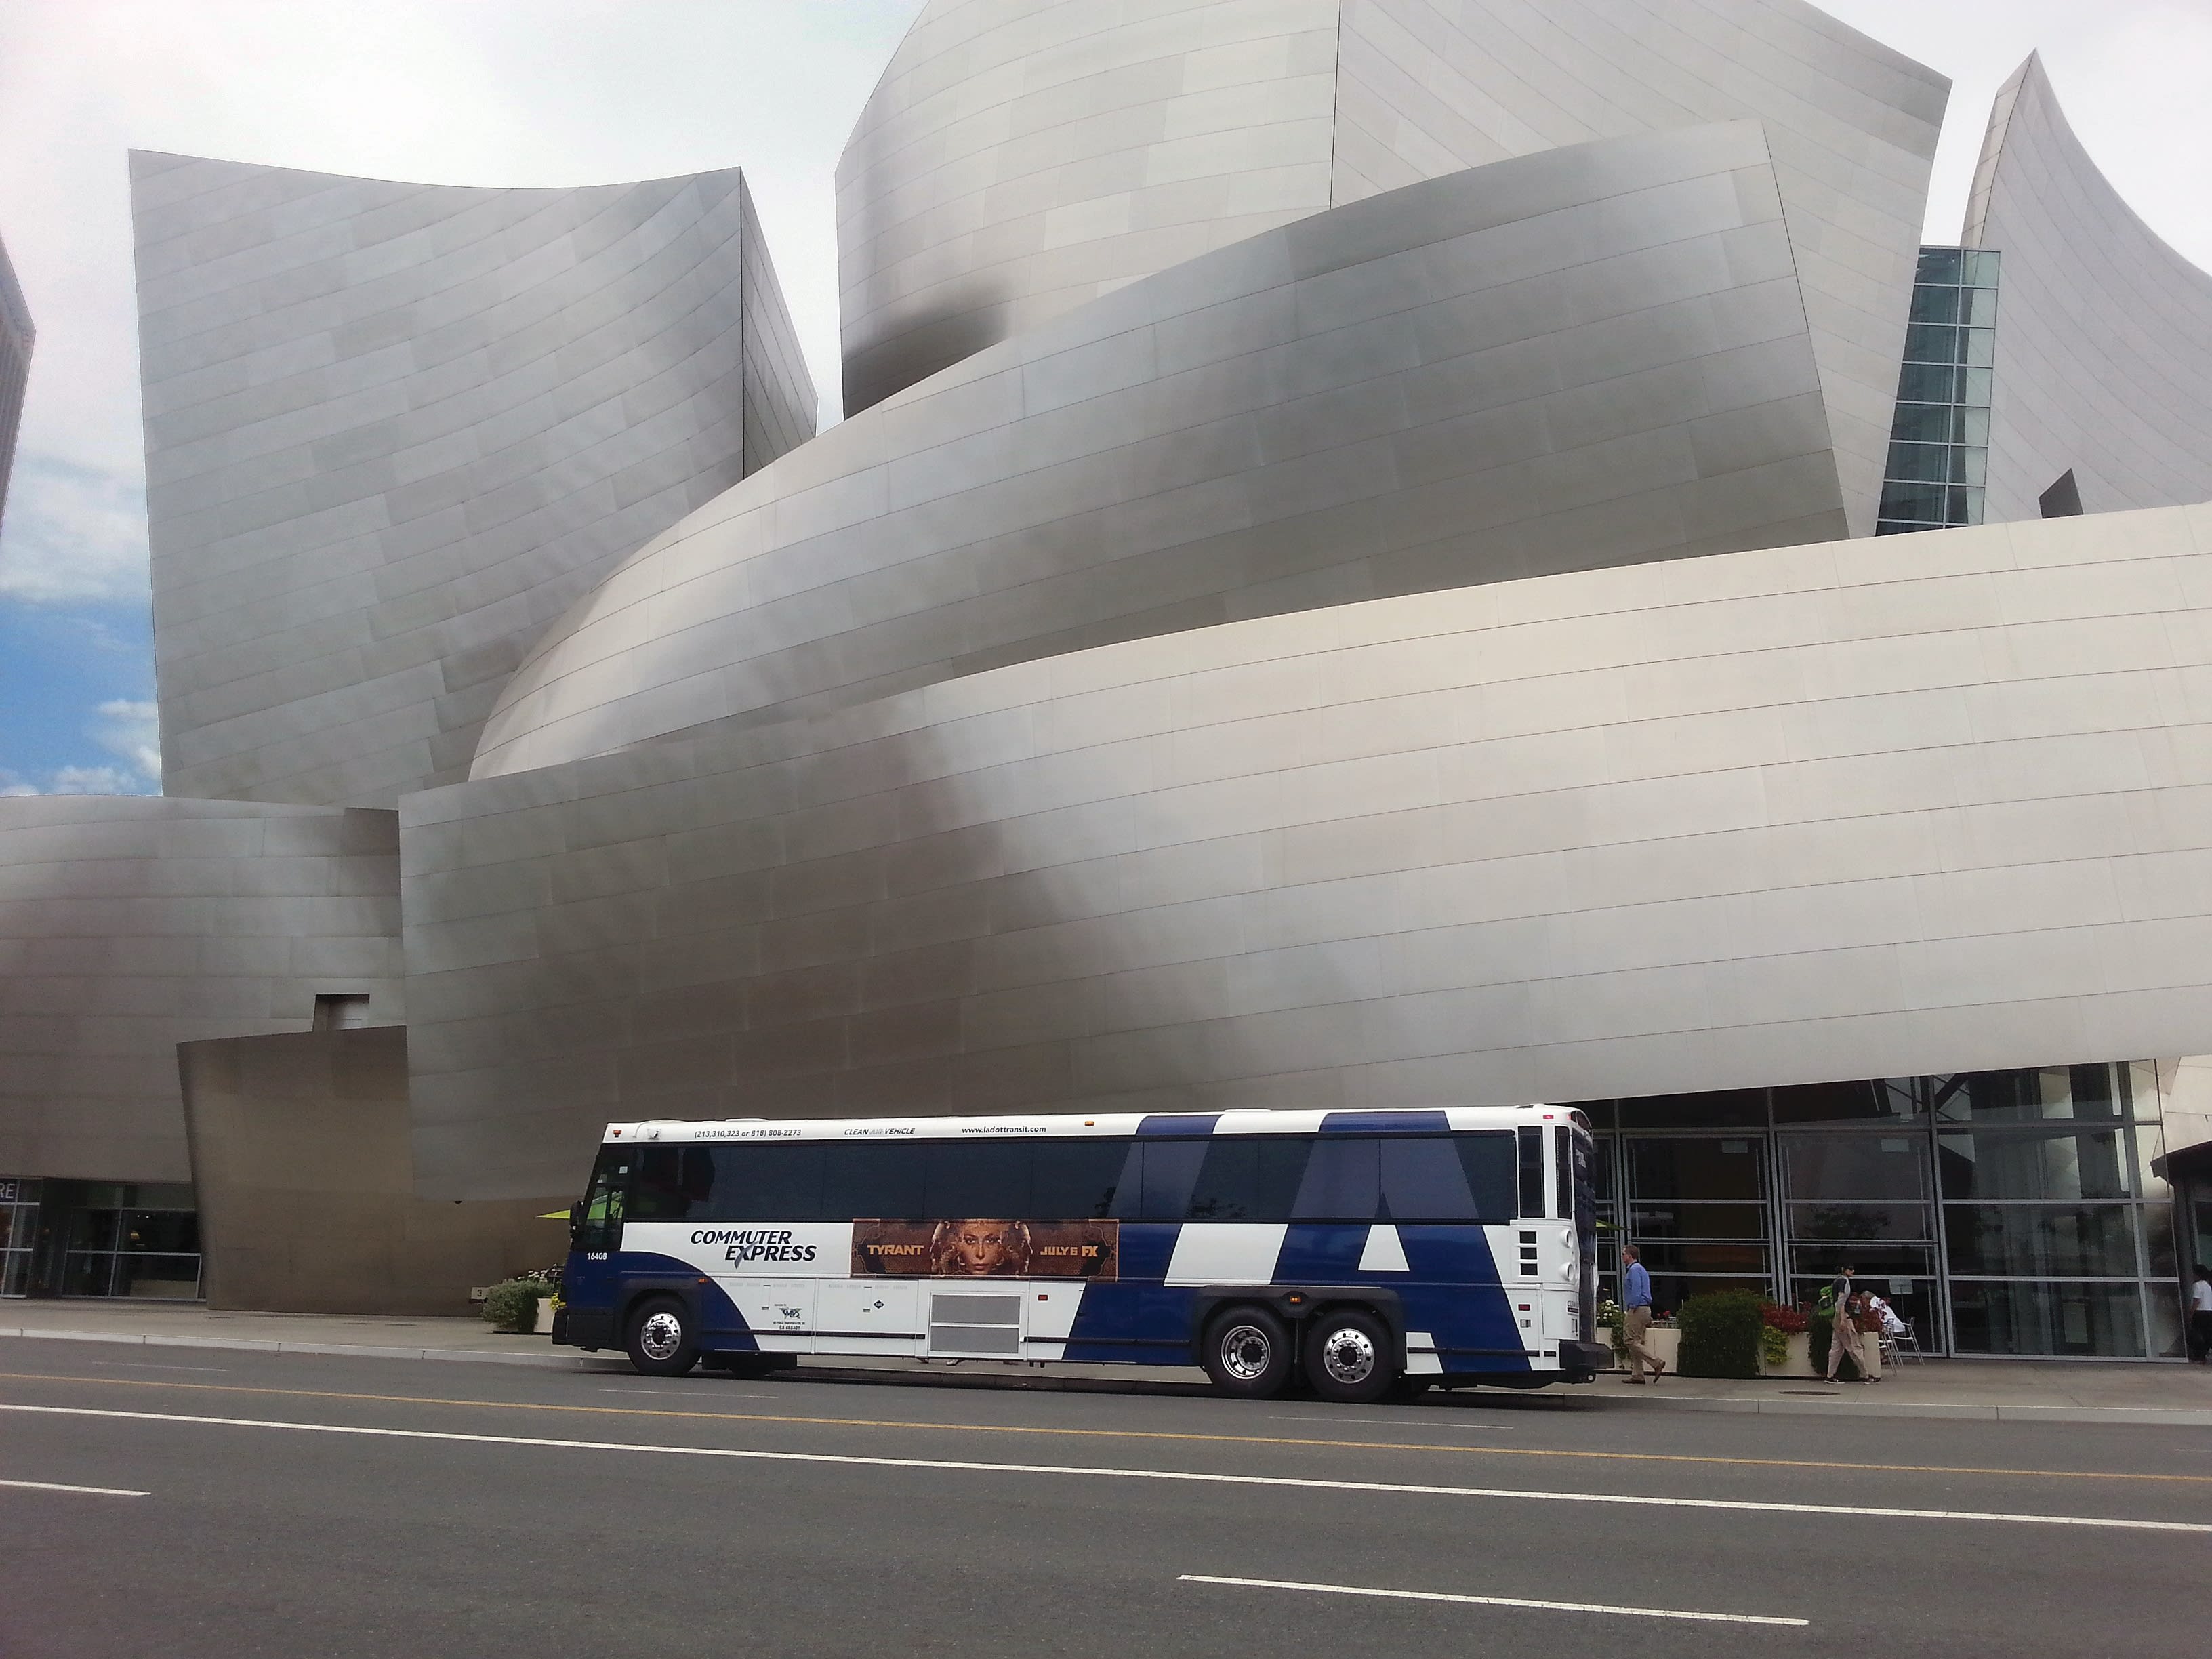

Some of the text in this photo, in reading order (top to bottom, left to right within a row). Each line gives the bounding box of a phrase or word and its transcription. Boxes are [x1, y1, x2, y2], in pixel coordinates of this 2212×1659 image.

[751, 1130, 767, 1138] 818)
[962, 1126, 1046, 1134] www.ladottransit.com
[691, 1230, 792, 1244] COMMUTER
[725, 1244, 817, 1267] EXPRESS
[867, 1244, 924, 1256] TYRANT
[1082, 1245, 1098, 1257] FX
[587, 1252, 607, 1261] 16408
